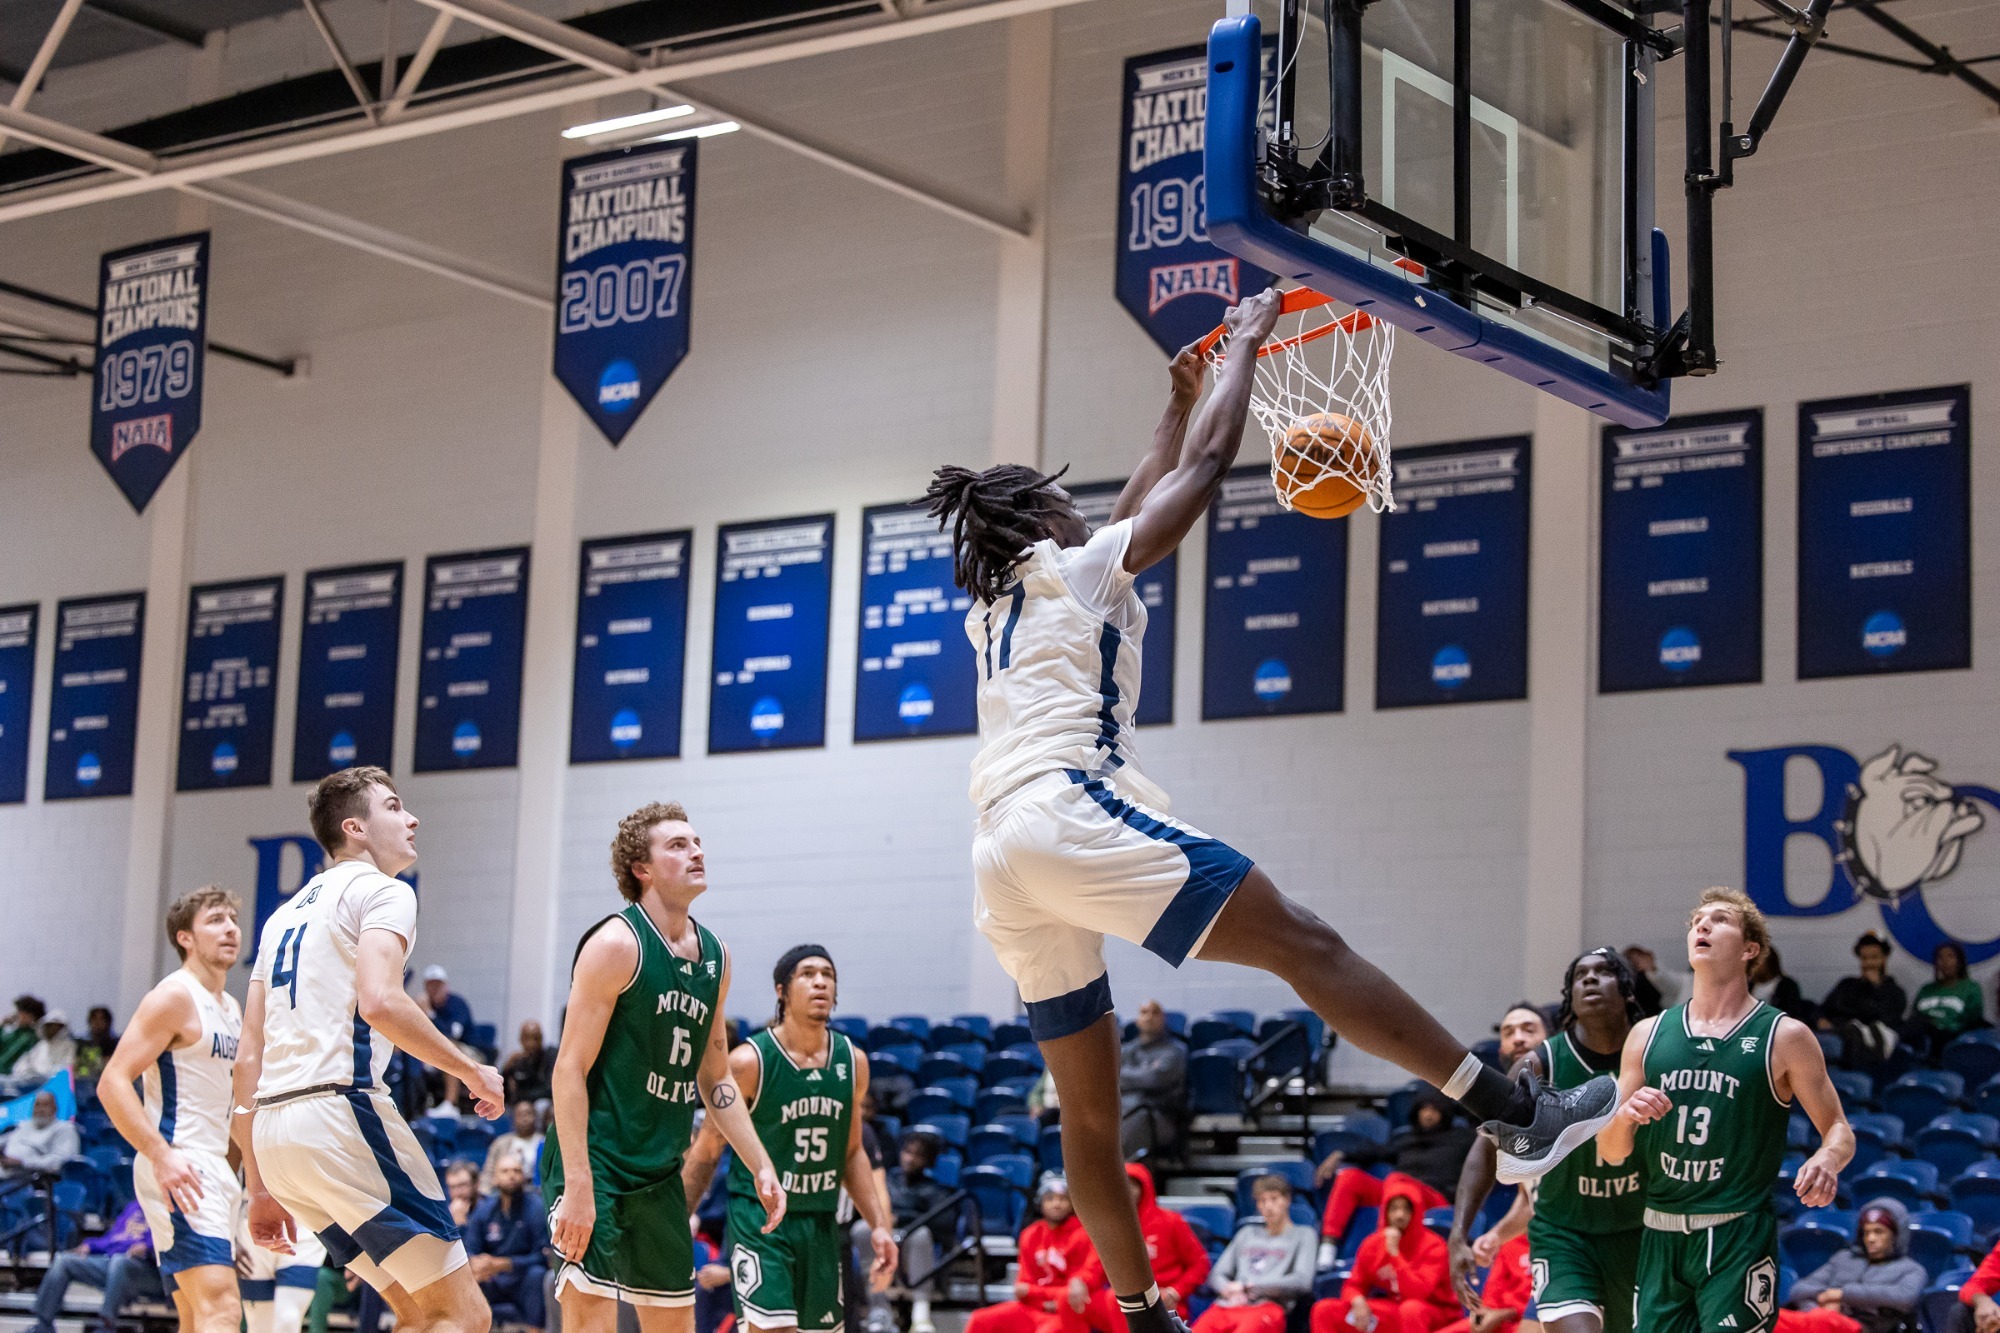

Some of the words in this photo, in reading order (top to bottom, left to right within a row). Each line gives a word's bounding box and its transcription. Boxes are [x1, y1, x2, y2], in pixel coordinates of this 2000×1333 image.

[569, 175, 686, 223] NATIONAL
[1129, 175, 1211, 251] 198
[566, 203, 686, 263] CHAMPIONS
[104, 267, 200, 312] NATIONAL
[560, 253, 686, 334] 2007
[1155, 263, 1232, 302] NAIA
[101, 297, 199, 348] CHAMPIONS
[100, 340, 194, 411] 1979
[117, 419, 167, 447] NAIA
[272, 922, 308, 1011] 4
[669, 1026, 692, 1068] 15
[1660, 1069, 1740, 1100] MOUNT
[781, 1096, 844, 1125] MOUNT
[1676, 1105, 1712, 1146] 13
[794, 1127, 829, 1163] 55
[782, 1169, 837, 1194] OLIVE
[1578, 1171, 1640, 1198] OLIVE
